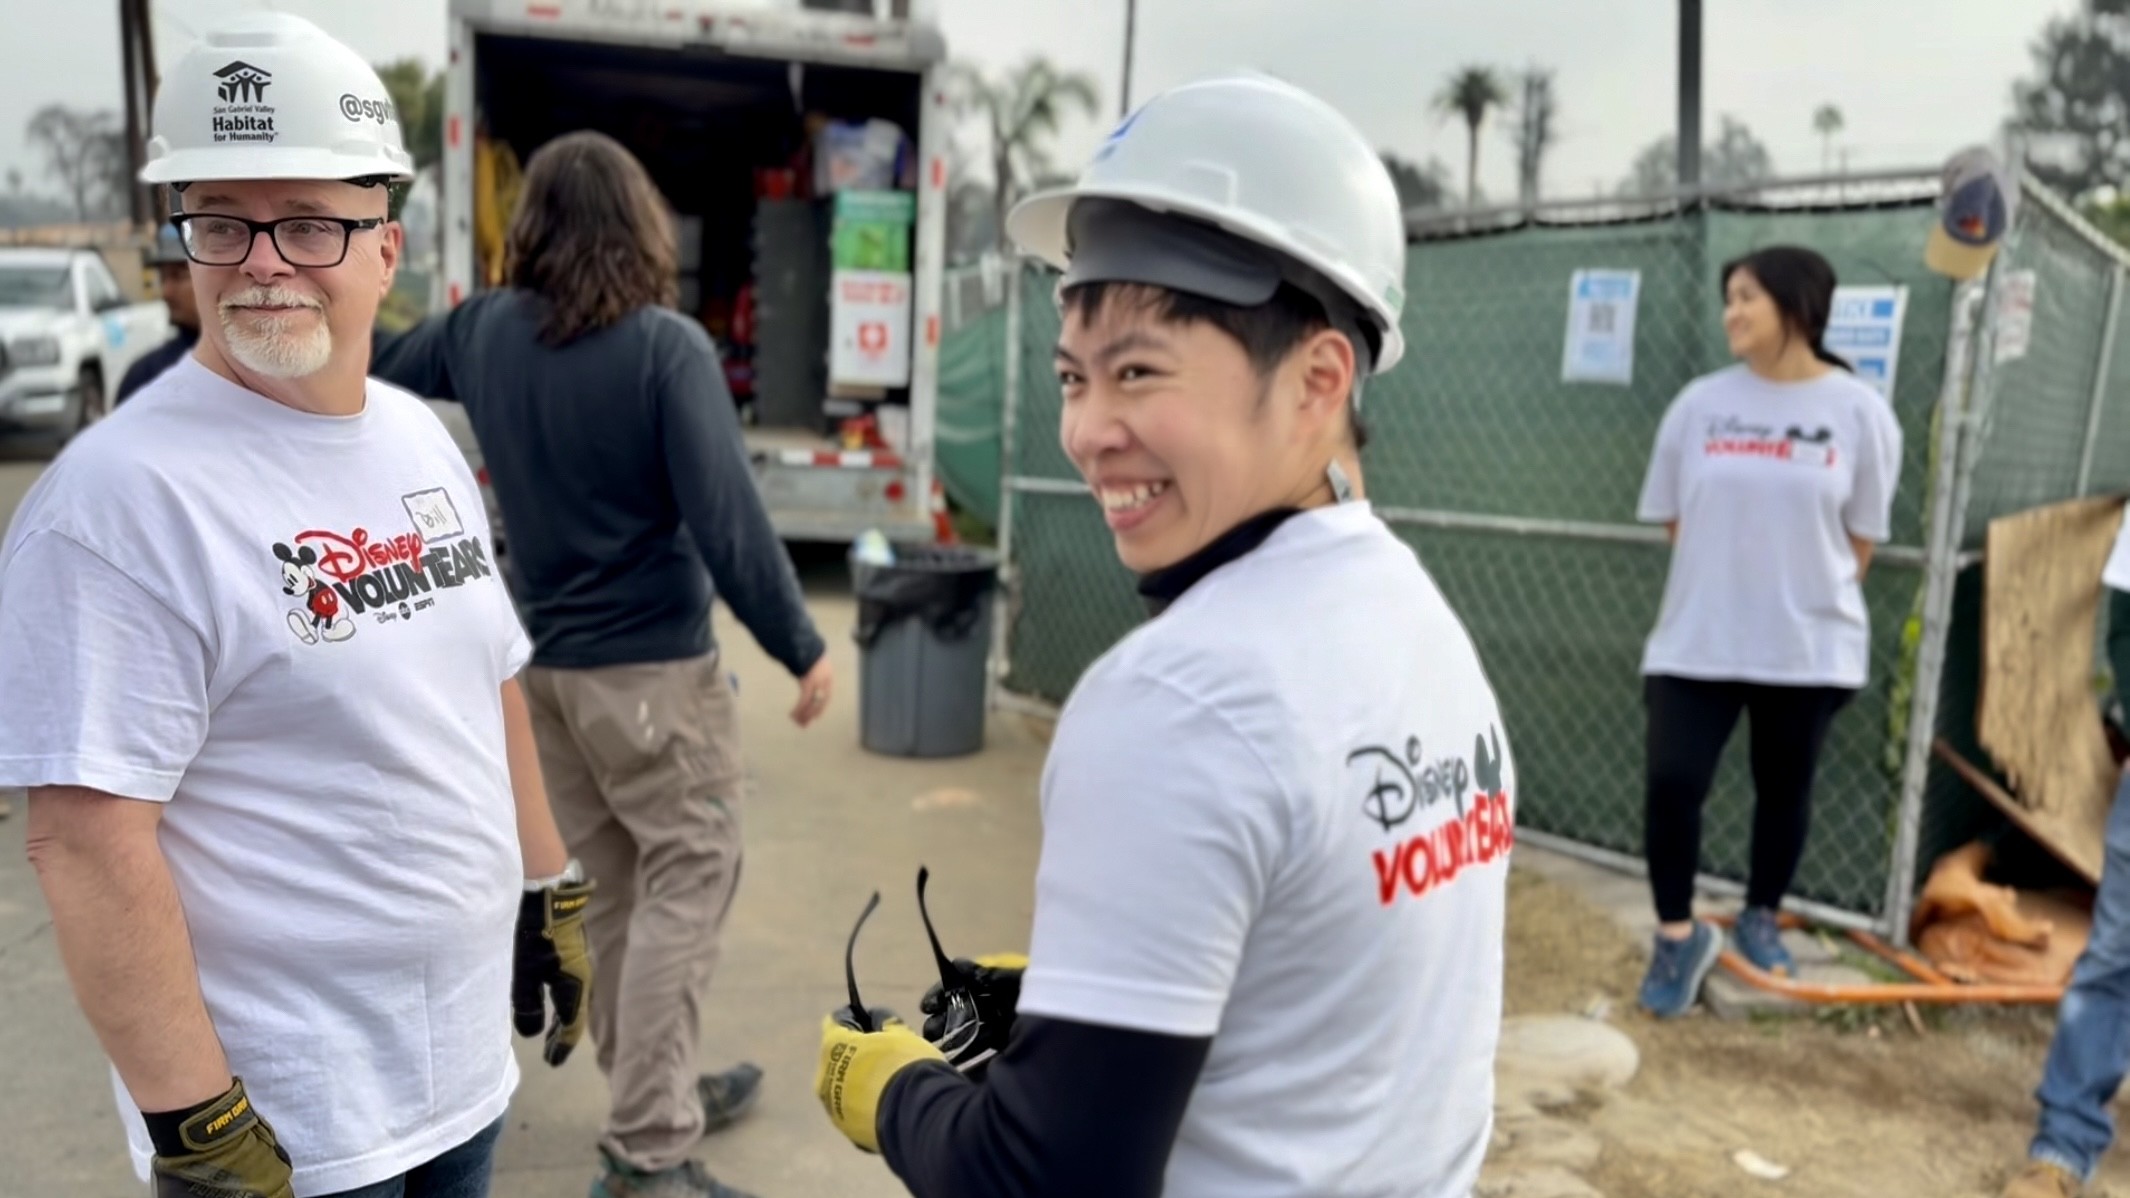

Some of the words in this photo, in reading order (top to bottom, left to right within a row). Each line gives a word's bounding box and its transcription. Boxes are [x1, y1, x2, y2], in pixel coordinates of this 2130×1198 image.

[213, 106, 226, 114] San
[228, 105, 253, 113] Gabriel
[255, 105, 275, 113] Valley
[213, 116, 274, 132] Habitat
[214, 133, 226, 142] for
[332, 536, 491, 614] VOLUNTEARS
[414, 597, 435, 611] ESPN
[836, 1046, 857, 1082] FIRM
[206, 1110, 234, 1135] FIRM
